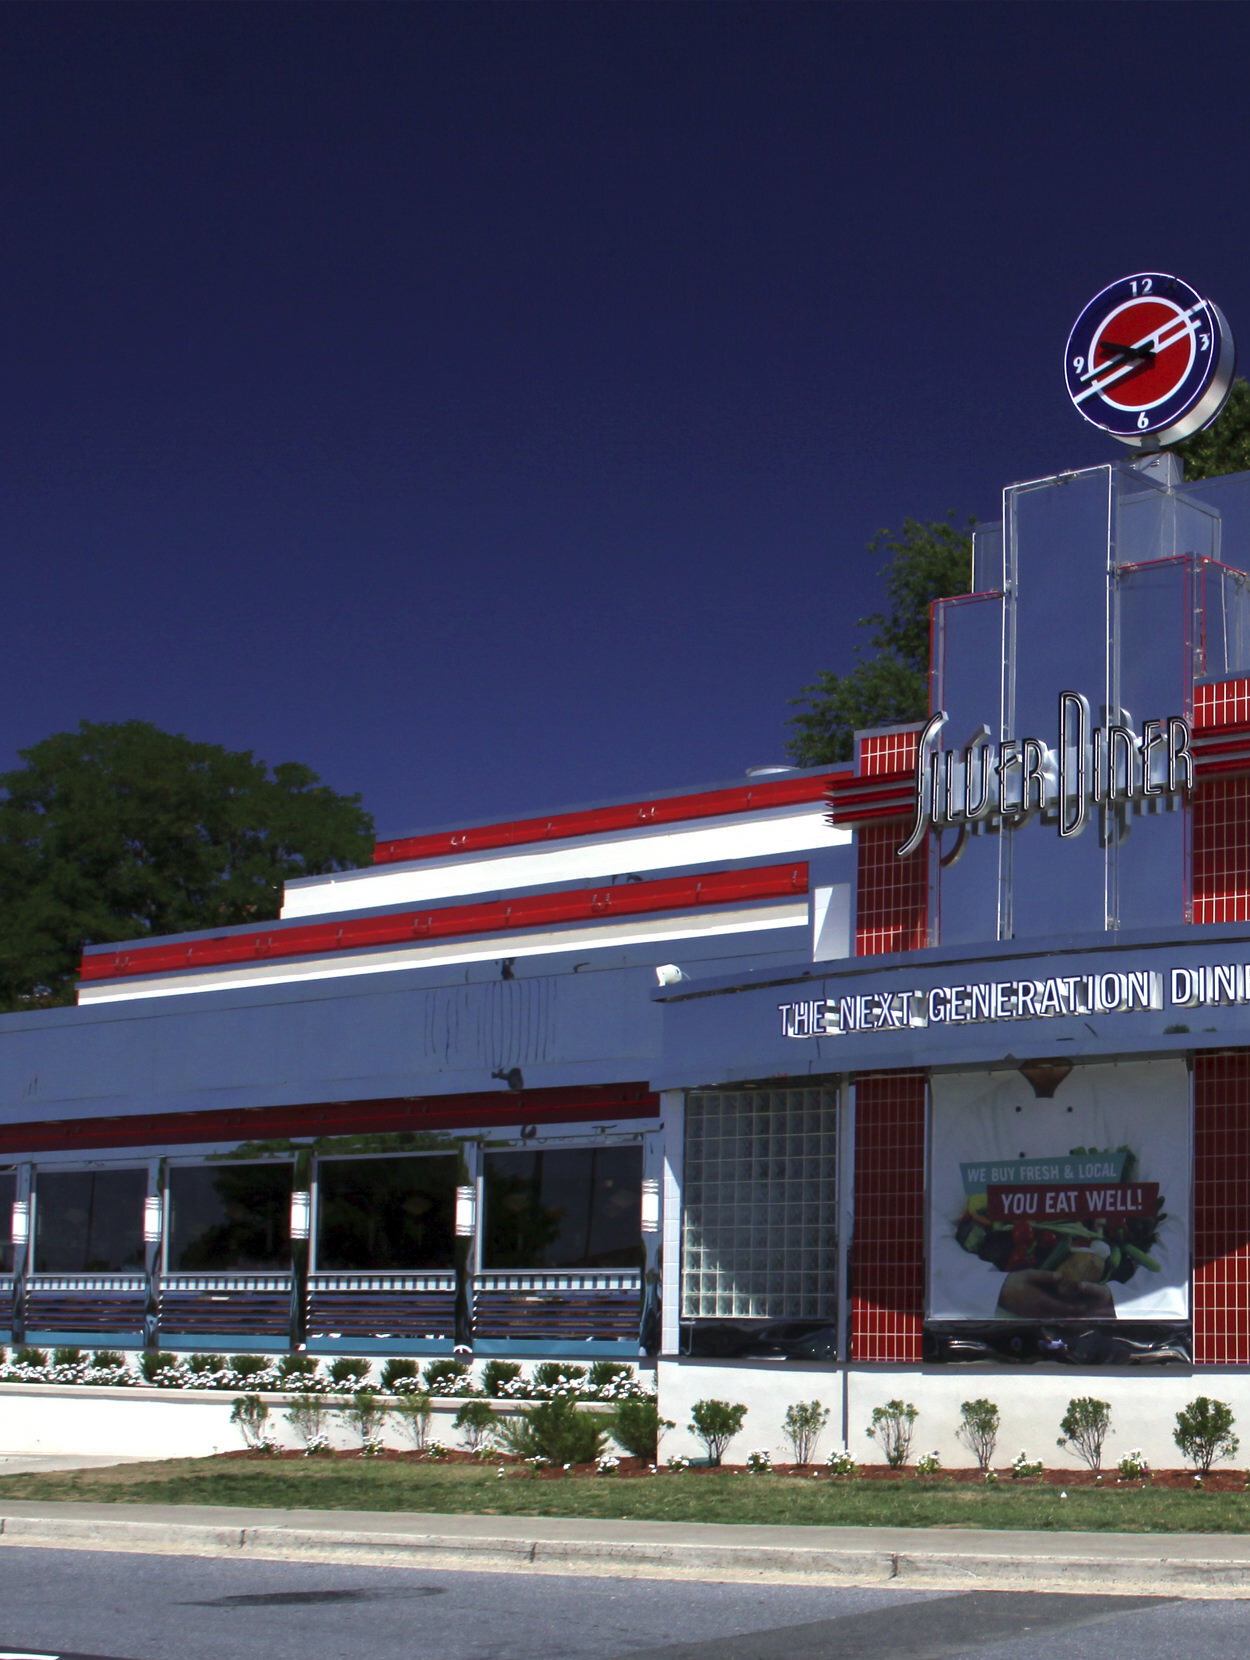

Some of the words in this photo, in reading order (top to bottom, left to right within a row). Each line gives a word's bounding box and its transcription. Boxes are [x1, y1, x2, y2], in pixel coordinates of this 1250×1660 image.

[1129, 278, 1153, 297] 12
[1199, 332, 1211, 352] 3
[1072, 356, 1085, 374] 9
[1136, 411, 1149, 429] 6
[1058, 689, 1195, 838] DINER
[777, 1000, 828, 1037] THE
[838, 990, 915, 1030] NEXT
[927, 970, 1152, 1023] GENERATION
[967, 1167, 987, 1183] WE
[991, 1166, 1016, 1183] BUY
[1019, 1164, 1060, 1182] FRESH
[1063, 1164, 1075, 1179] &
[1078, 1162, 1117, 1179] LOCAL
[1001, 1192, 1038, 1215] YOU
[1045, 1191, 1080, 1214] EAT
[1086, 1188, 1143, 1213] WELL!
